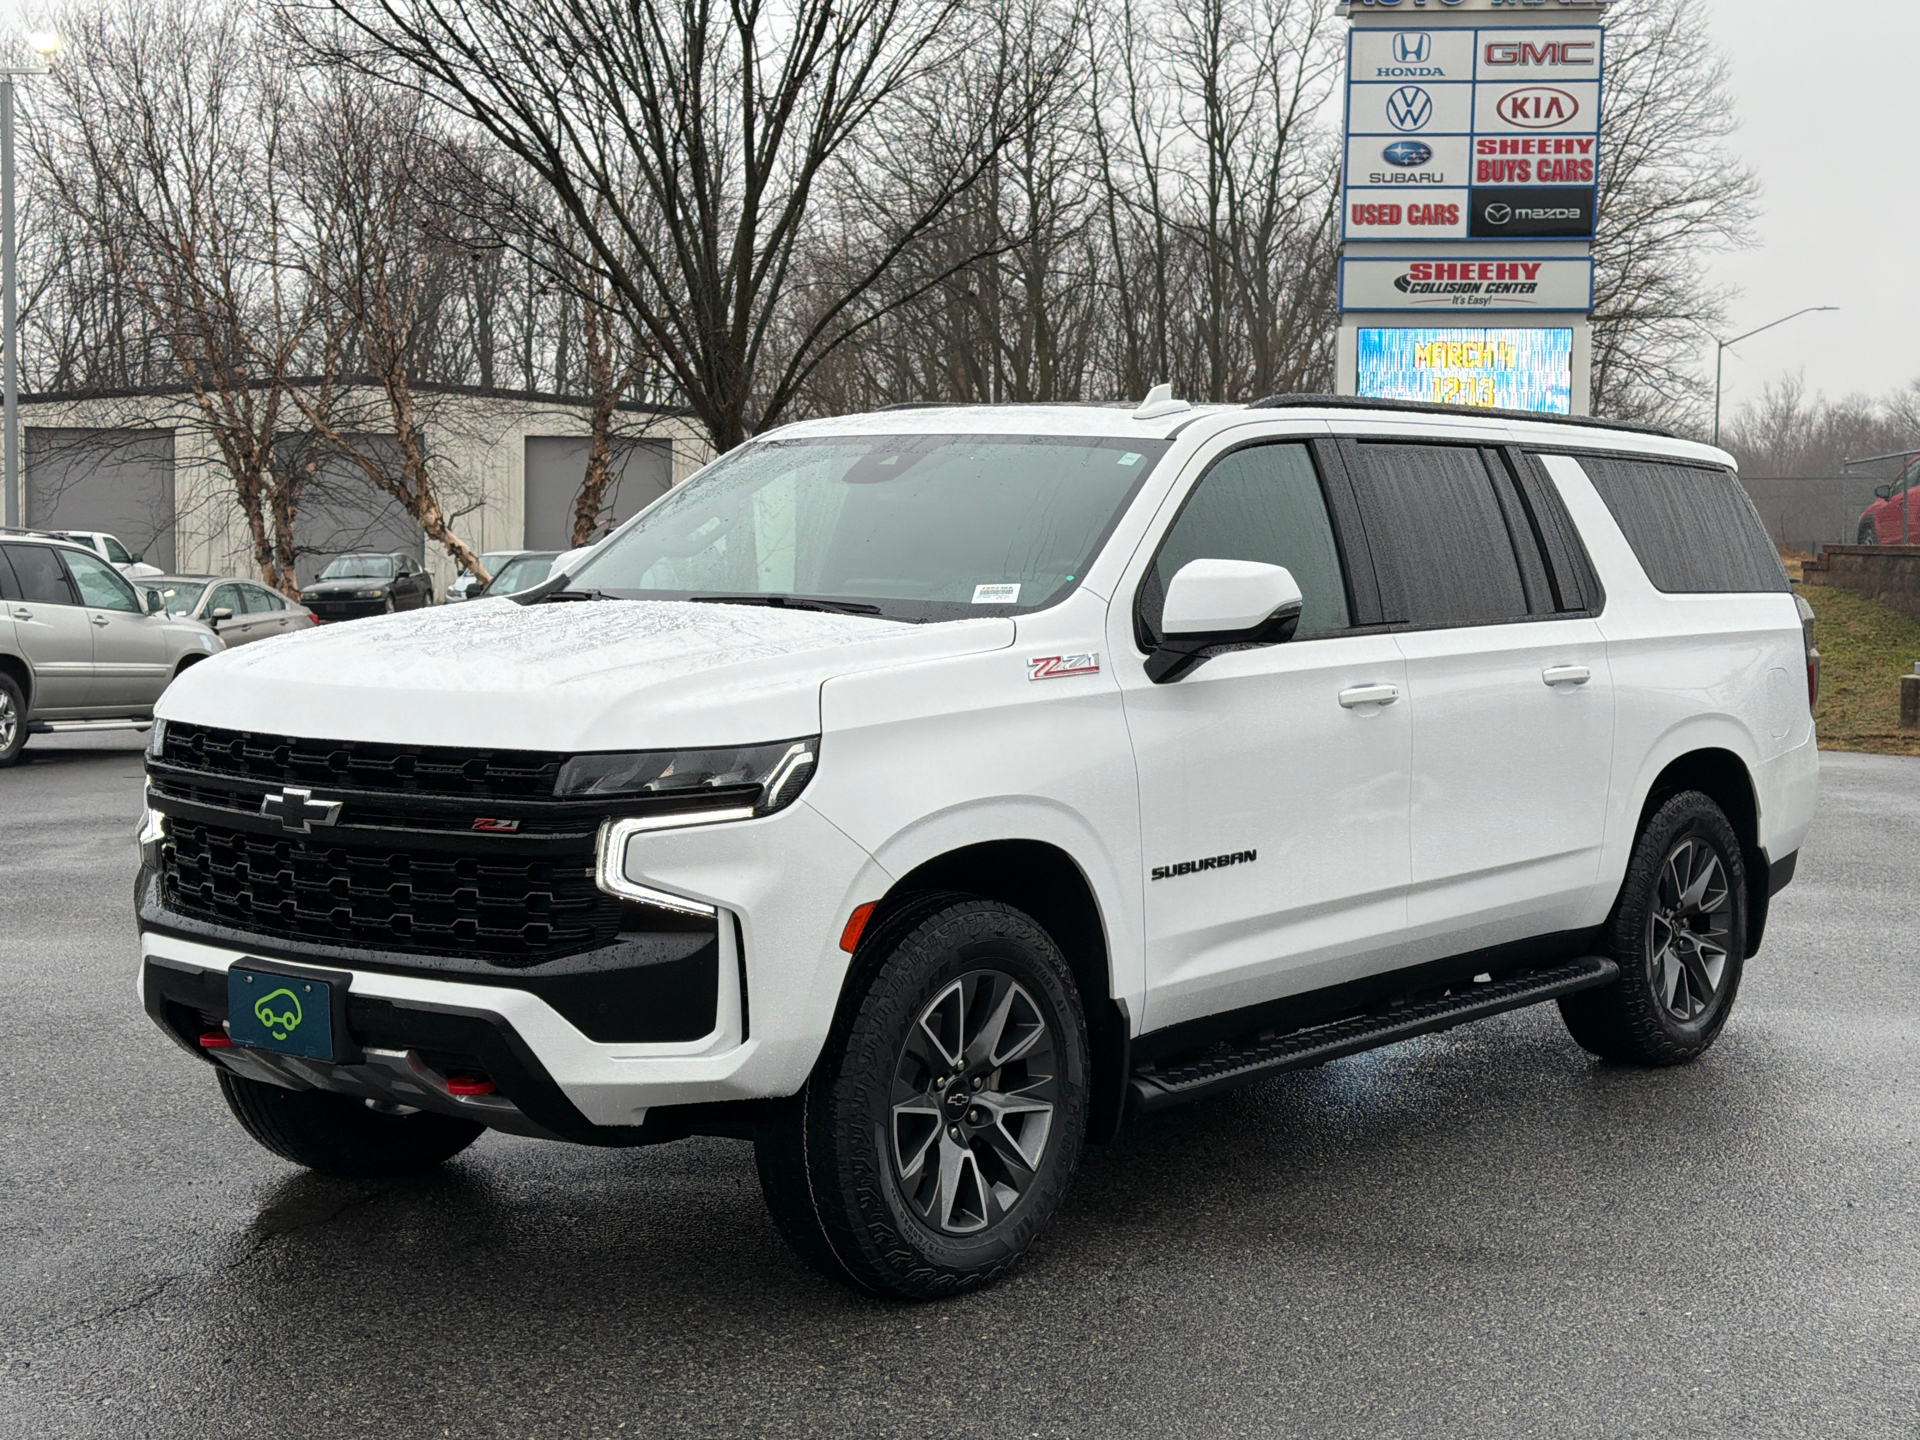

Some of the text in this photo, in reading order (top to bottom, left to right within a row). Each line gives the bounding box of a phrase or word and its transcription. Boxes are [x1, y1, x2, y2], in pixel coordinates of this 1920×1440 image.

[1484, 41, 1595, 66] GMC
[1375, 67, 1446, 77] HONDA
[1510, 96, 1565, 119] KIA
[1476, 138, 1595, 155] SHEEHY
[1368, 172, 1444, 184] SUBARU
[1476, 158, 1593, 182] BUYS CARS
[1351, 204, 1459, 225] USED CARS
[1409, 262, 1543, 281] SHEEHY
[1409, 282, 1538, 294] COLLISION CENTER
[1451, 294, 1493, 307] It's Easy!
[1413, 341, 1494, 369] MARCH
[1432, 376, 1495, 408] 12:13
[1026, 653, 1100, 681] Z71
[471, 817, 520, 831] Z71
[1150, 849, 1257, 881] SUBURBAN
